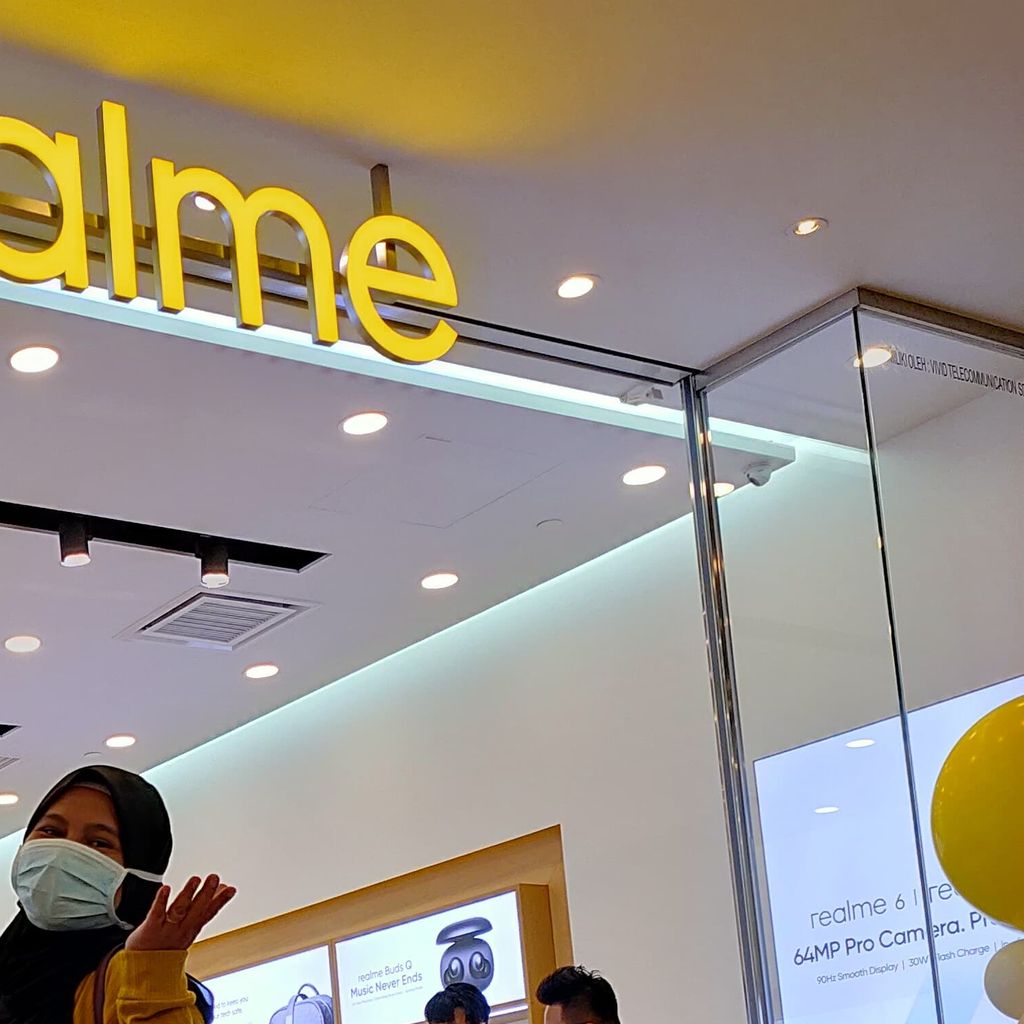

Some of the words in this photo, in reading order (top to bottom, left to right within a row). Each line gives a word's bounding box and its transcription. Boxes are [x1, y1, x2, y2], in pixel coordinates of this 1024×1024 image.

[810, 898, 887, 929] realme
[895, 893, 906, 910] 6
[793, 941, 841, 966] 64MP
[844, 937, 875, 956] Pro
[937, 949, 956, 962] lash
[375, 979, 400, 993] Never
